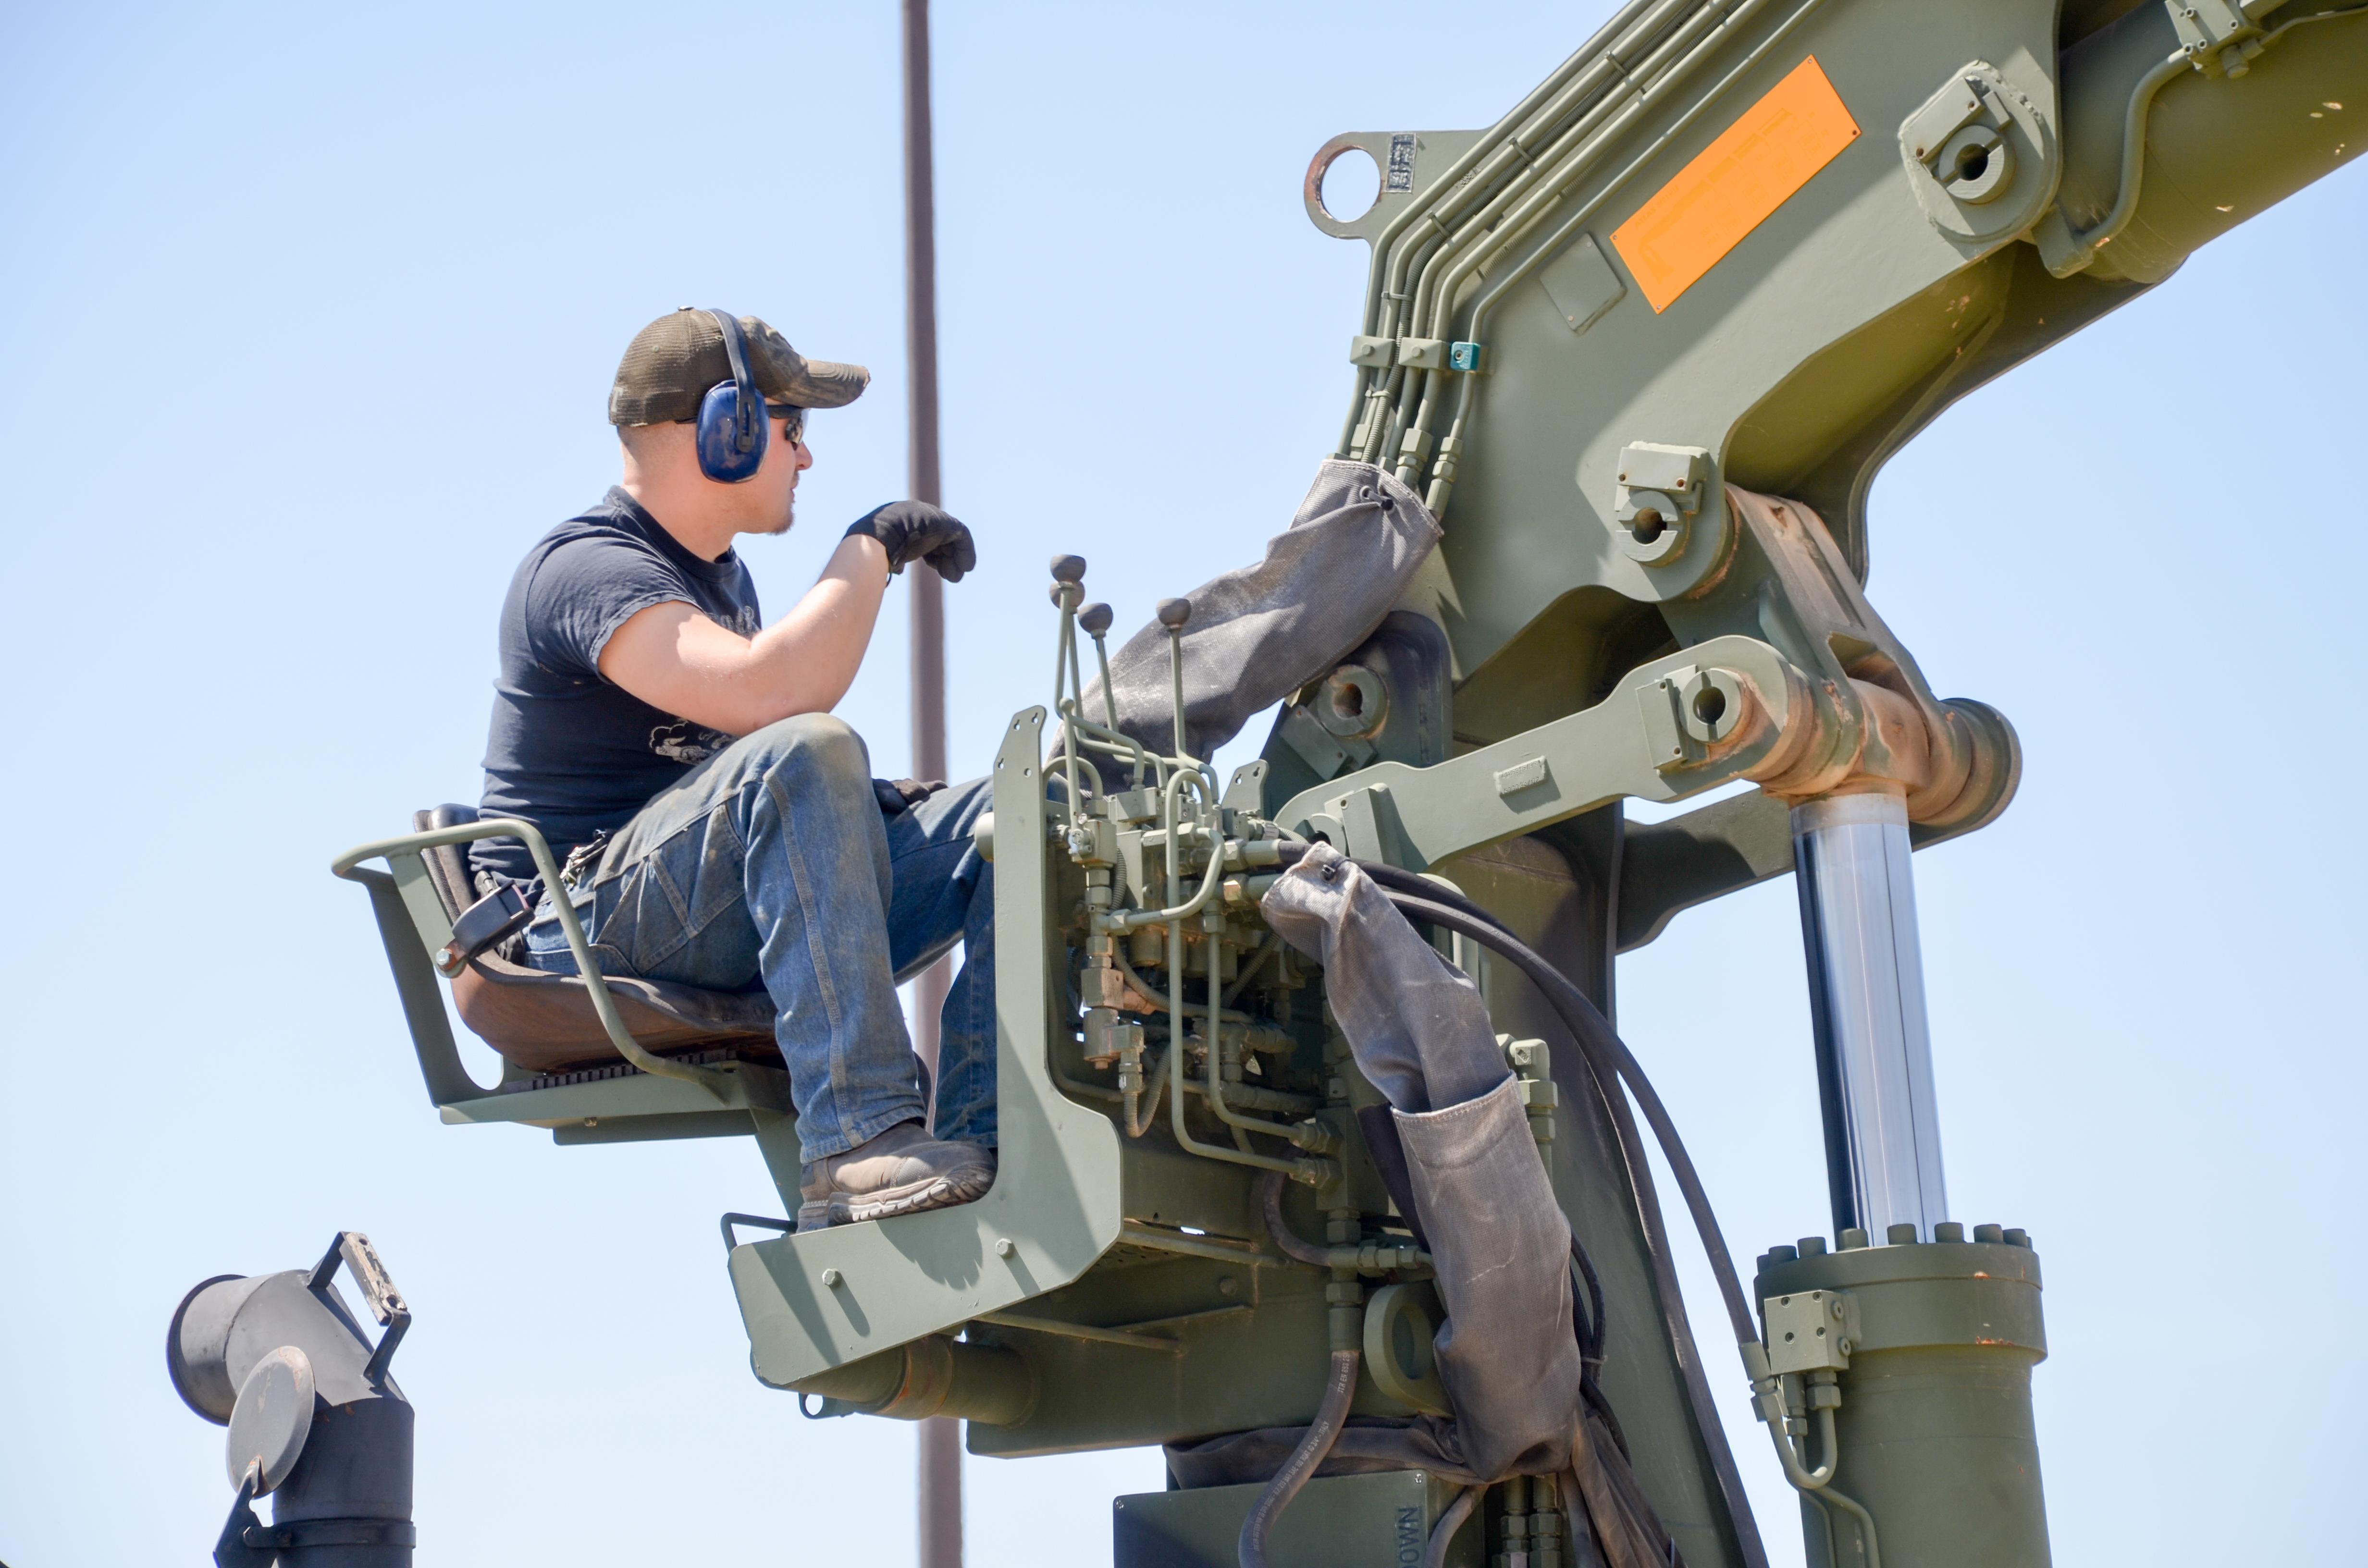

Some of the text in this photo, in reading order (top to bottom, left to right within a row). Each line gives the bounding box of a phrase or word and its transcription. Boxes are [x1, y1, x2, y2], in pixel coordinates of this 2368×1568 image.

[1340, 1373, 1347, 1382] EN
[1288, 1465, 1299, 1475] SAE
[1319, 1421, 1330, 1435] ITALY
[1398, 1507, 1420, 1568] OWN
